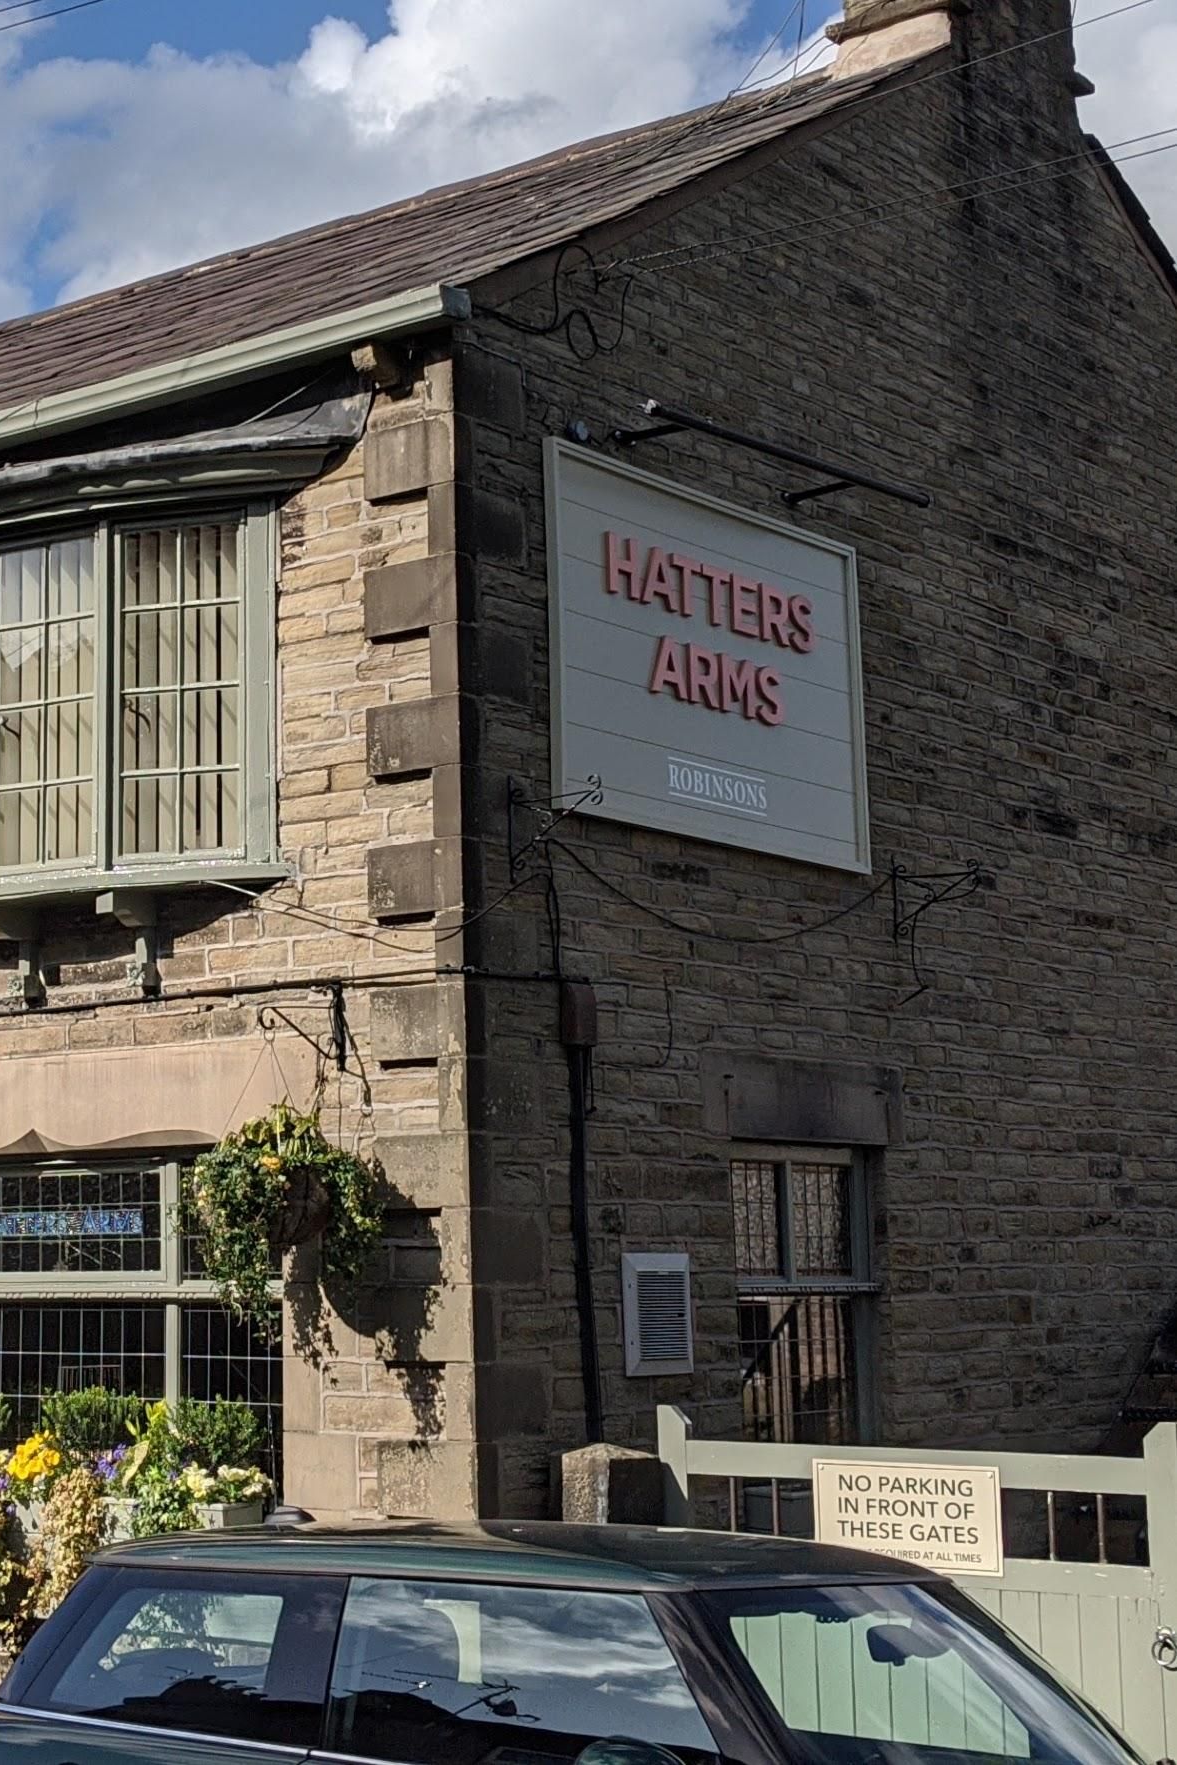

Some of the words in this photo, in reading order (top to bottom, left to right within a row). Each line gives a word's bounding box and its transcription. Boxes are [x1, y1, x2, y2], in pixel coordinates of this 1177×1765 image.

[605, 531, 815, 654] HATTERS
[650, 635, 786, 727] ARMS
[668, 764, 768, 810] ROBINSONS
[838, 1474, 871, 1492] NO
[879, 1476, 973, 1497] PARKING
[838, 1497, 859, 1514] IN
[866, 1498, 938, 1518] FRONT
[944, 1502, 975, 1520] OF
[837, 1520, 903, 1540] THESE
[910, 1524, 979, 1545] GATES
[923, 1551, 934, 1560] AT
[935, 1551, 952, 1561] ALL
[954, 1553, 982, 1563] TIMES
